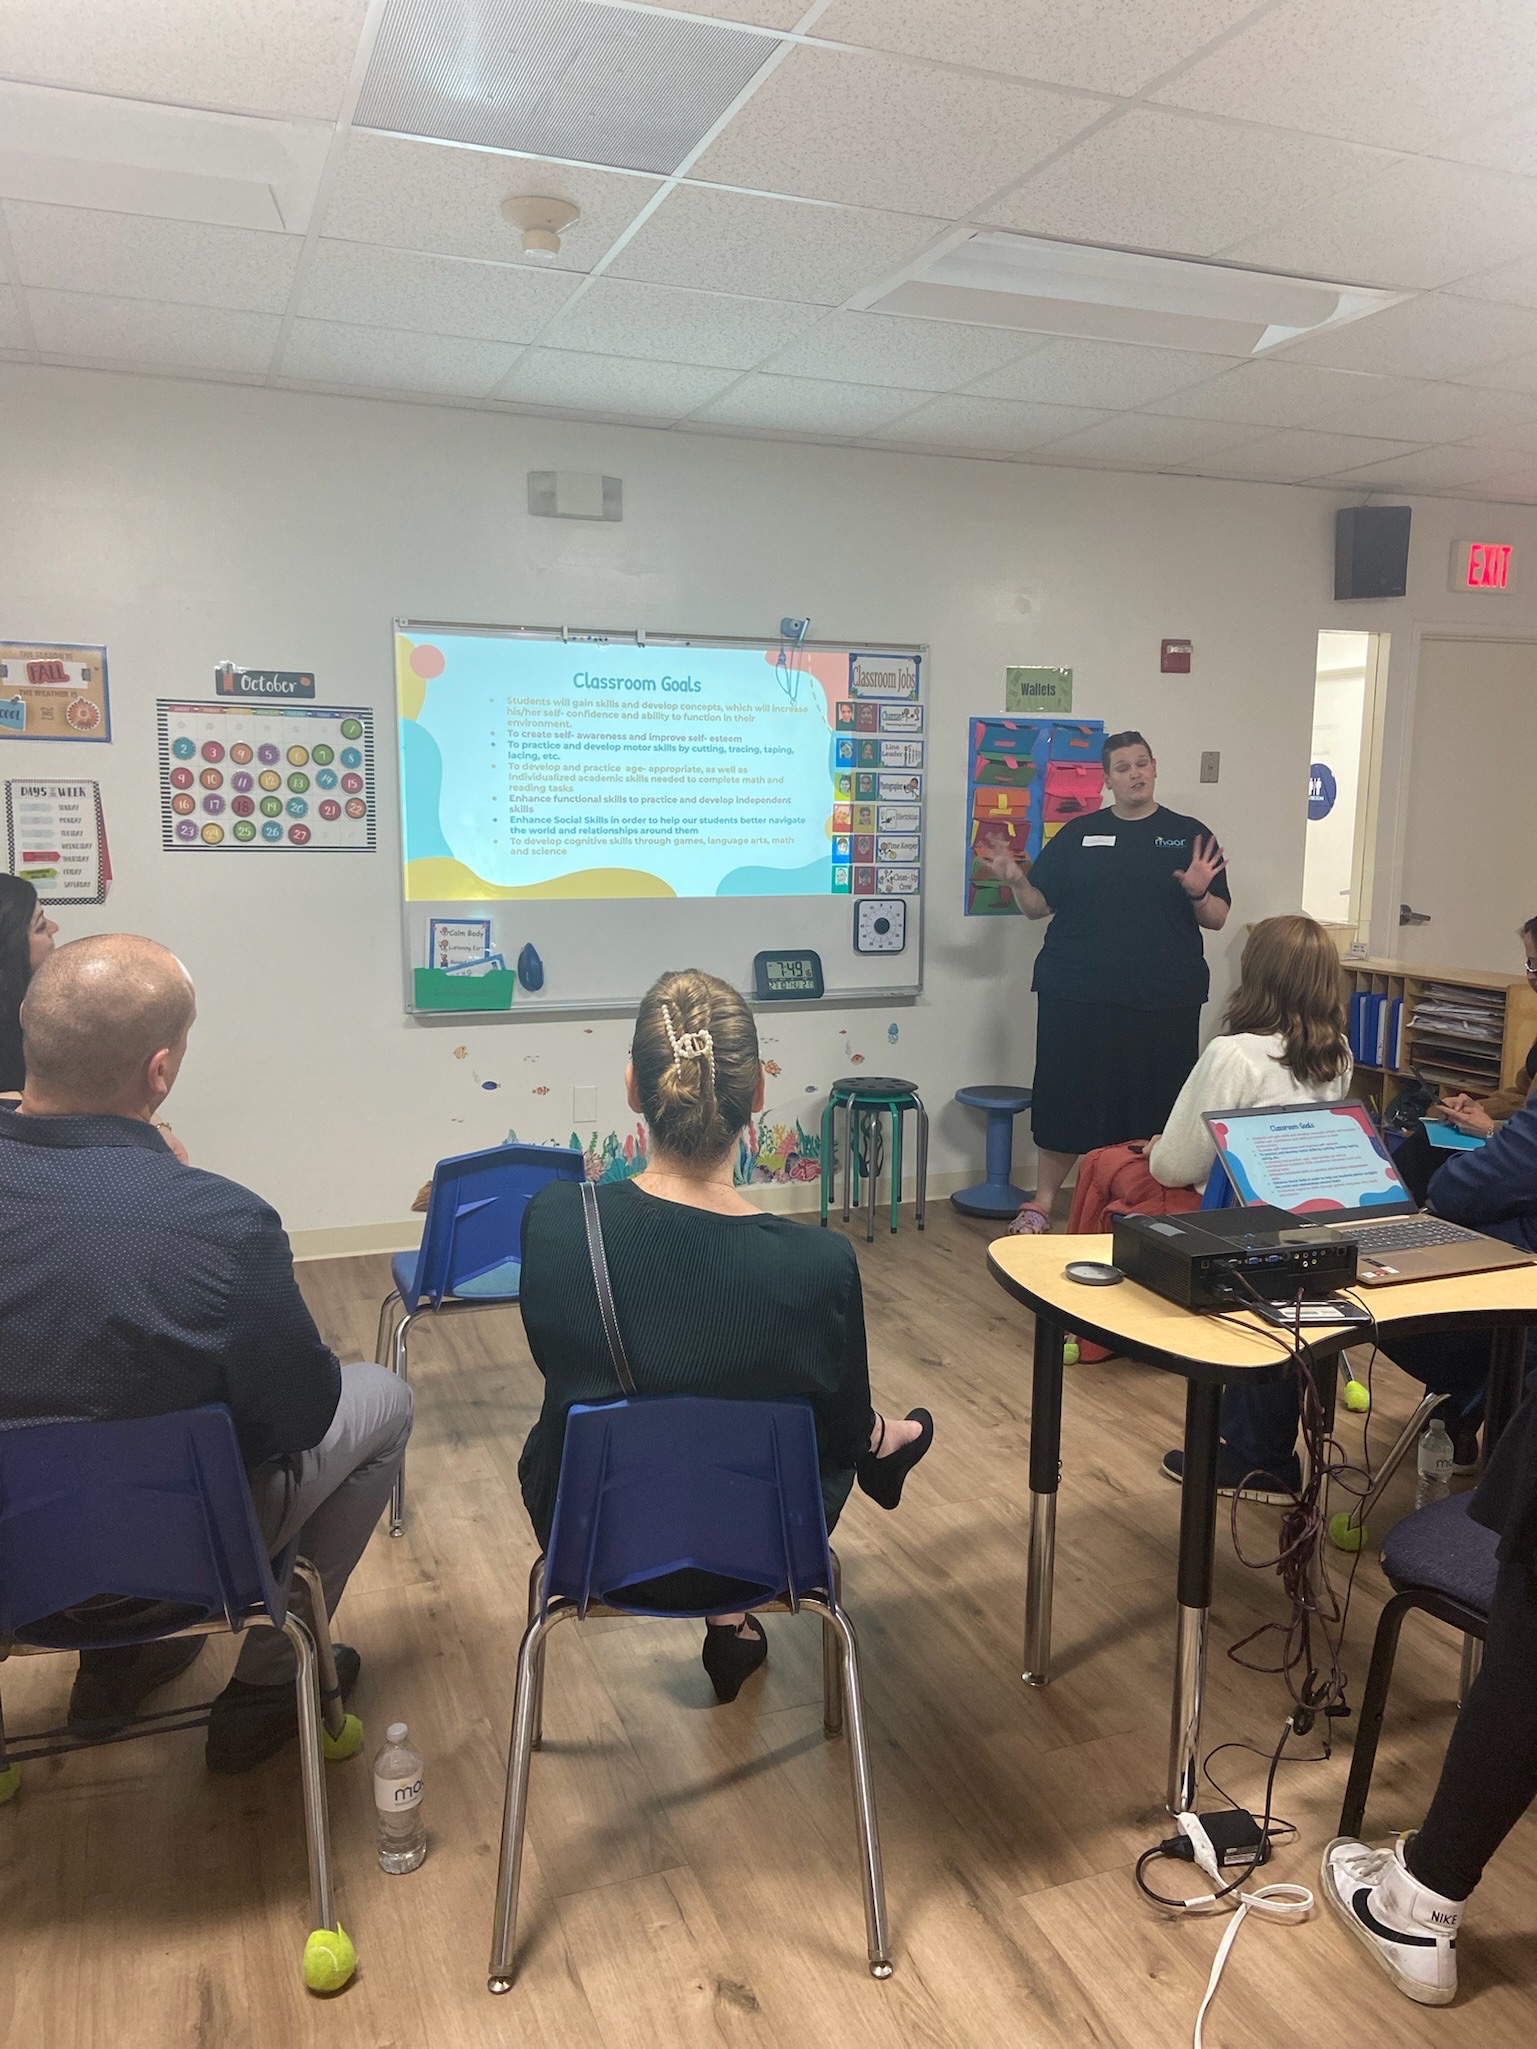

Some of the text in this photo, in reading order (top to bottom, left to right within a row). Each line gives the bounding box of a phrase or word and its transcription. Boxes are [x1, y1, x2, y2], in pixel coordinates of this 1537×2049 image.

[1467, 544, 1512, 588] EXIT
[30, 664, 66, 680] FALL
[854, 664, 915, 692] Classroom Jobs
[240, 673, 298, 694] October
[573, 672, 701, 692] Classroom Goals
[1020, 682, 1056, 696] Wallets
[506, 696, 808, 713] Students will gain skills and develop concepts, which will increase
[507, 707, 755, 722] his/her self- confidence and ability to function in their
[350, 725, 355, 734] 1
[507, 719, 572, 728] environment.
[554, 730, 574, 739] self-
[629, 733, 646, 741] and
[649, 734, 686, 743] improve
[688, 734, 707, 742] self-
[710, 735, 742, 743] esteem
[180, 744, 188, 754] 2
[209, 748, 217, 757] 3
[237, 750, 245, 759] 4
[265, 750, 272, 760] 5
[295, 751, 301, 760] 6
[319, 750, 326, 760] 7
[522, 741, 561, 751] practice
[563, 742, 581, 750] and
[584, 742, 621, 752] develop
[623, 743, 651, 751] motor
[654, 744, 676, 752] skills
[679, 744, 689, 753] by
[692, 745, 727, 753] cutting,
[729, 745, 762, 754] tracing,
[764, 746, 794, 755] taping,
[882, 750, 902, 758] Leader
[508, 752, 560, 761] lacing, etc.
[522, 763, 560, 772] develop
[583, 764, 621, 773] practice
[625, 766, 646, 774] age-
[648, 765, 704, 774] appropriate,
[718, 766, 736, 774] well
[178, 774, 358, 788] 9 10 11 12 13 14 15
[509, 773, 784, 784] Individualized academic skills needed to complete math and
[21, 786, 47, 797] DAYS
[58, 787, 86, 797] WEEK
[509, 784, 546, 794] reading
[509, 794, 551, 803] Enhance
[553, 795, 601, 803] functional
[641, 796, 677, 804] practice
[680, 796, 696, 804] and
[699, 796, 734, 805] develop
[736, 796, 791, 805] independent
[179, 800, 362, 815] 16 17 18 19 20 21 22
[509, 805, 534, 813] skills
[510, 816, 552, 824] Enhance
[554, 816, 582, 824] Social
[584, 816, 608, 824] Skills
[611, 816, 619, 824] in
[621, 816, 646, 824] order
[660, 816, 680, 825] help
[699, 816, 738, 824] students
[740, 816, 767, 824] better
[769, 817, 806, 826] navigate
[180, 826, 306, 840] 23 24 25 26 27
[579, 826, 638, 836] relationships
[510, 837, 521, 845] To
[524, 837, 562, 846] develop
[564, 837, 608, 846] cognitive
[609, 837, 632, 845] skills
[634, 837, 671, 846] through
[673, 838, 706, 846] games,
[708, 837, 748, 846] language
[751, 837, 770, 845] arts,
[901, 843, 918, 851] Keeper
[531, 847, 567, 855] science
[468, 930, 484, 938] Body
[777, 962, 803, 976] 7:49
[1431, 1910, 1457, 1924] NIKE
